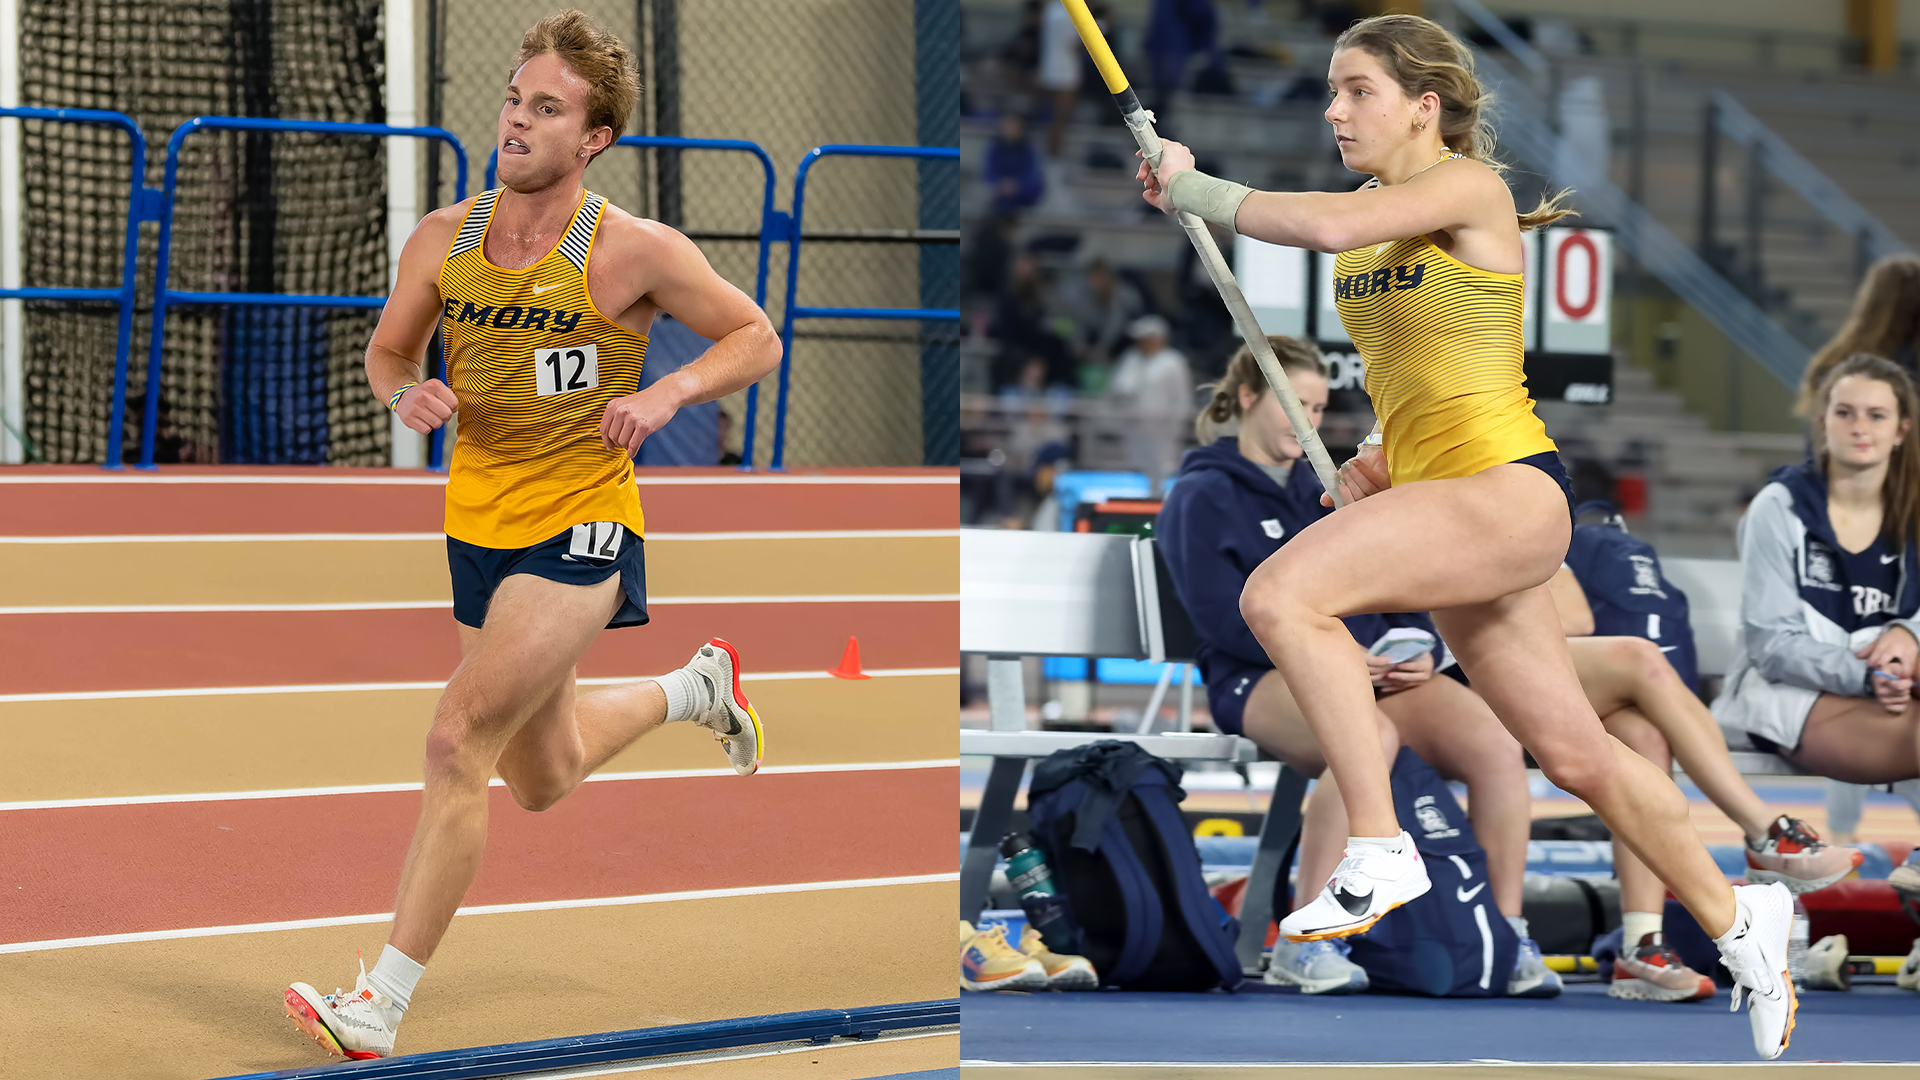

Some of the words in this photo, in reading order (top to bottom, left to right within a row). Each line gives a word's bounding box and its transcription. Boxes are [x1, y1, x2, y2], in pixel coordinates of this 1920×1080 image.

[1333, 264, 1425, 302] MORY
[1556, 230, 1599, 321] 0
[444, 298, 583, 334] EMORY
[545, 349, 588, 392] 12
[582, 521, 615, 557] 12
